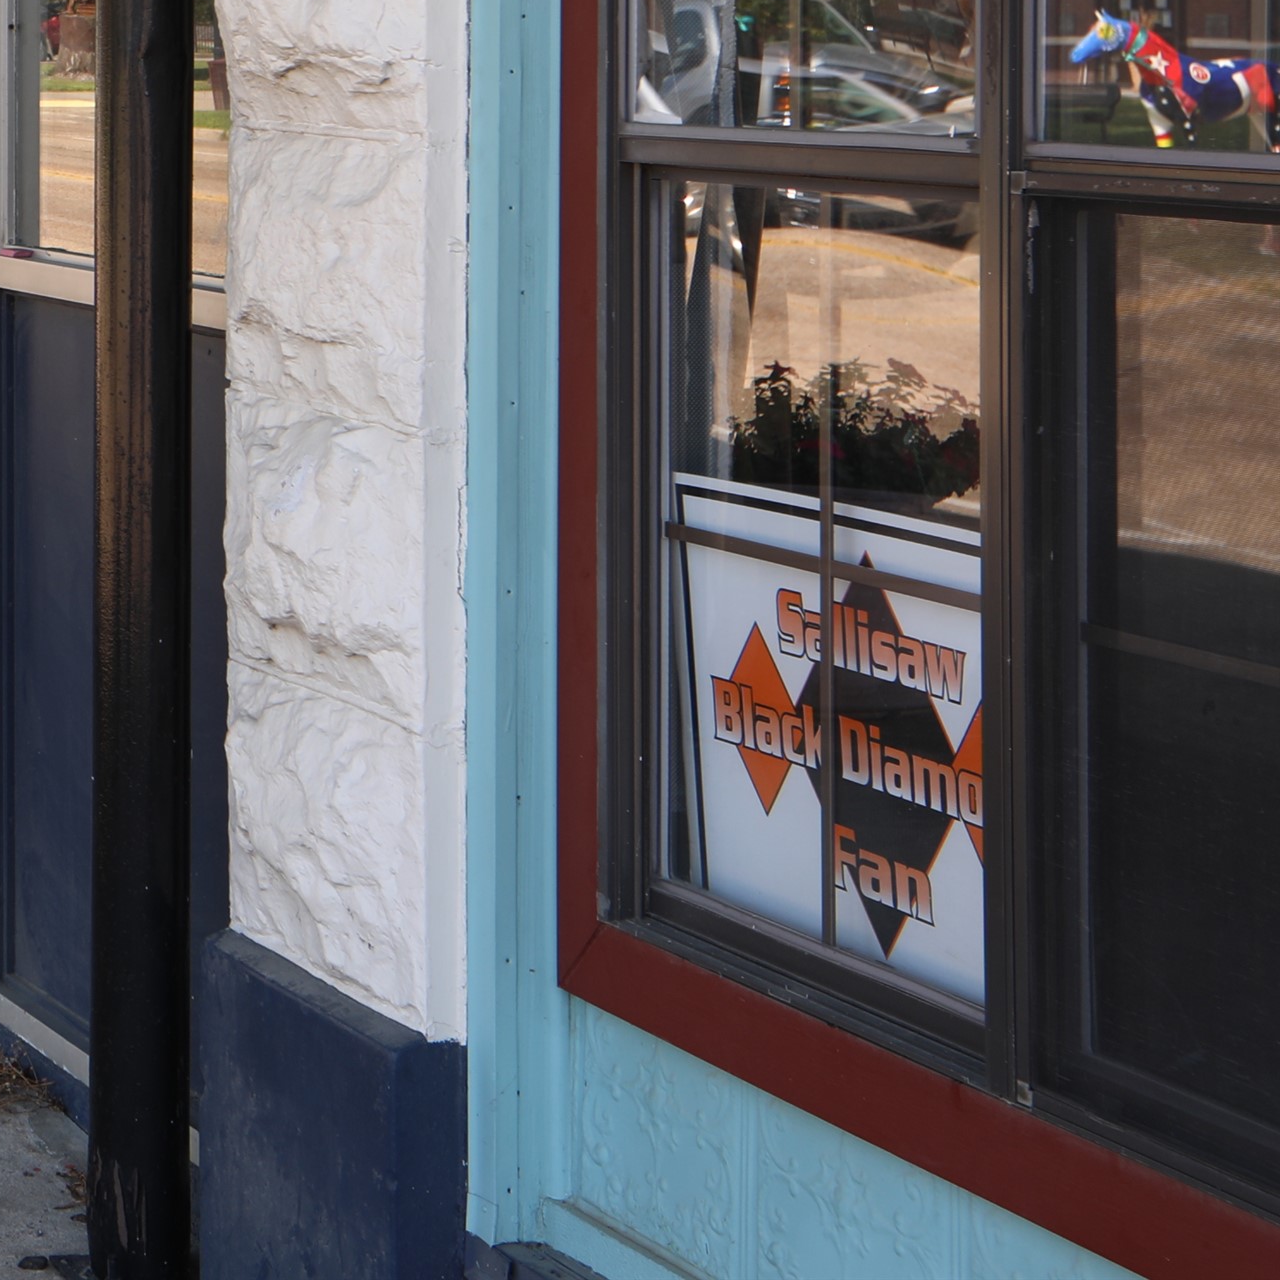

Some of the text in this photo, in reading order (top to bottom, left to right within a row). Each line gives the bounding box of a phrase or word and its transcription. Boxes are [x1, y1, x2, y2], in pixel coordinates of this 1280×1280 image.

[776, 587, 966, 706] Sallisaw
[710, 674, 822, 770] Black
[834, 822, 936, 928] Fan
